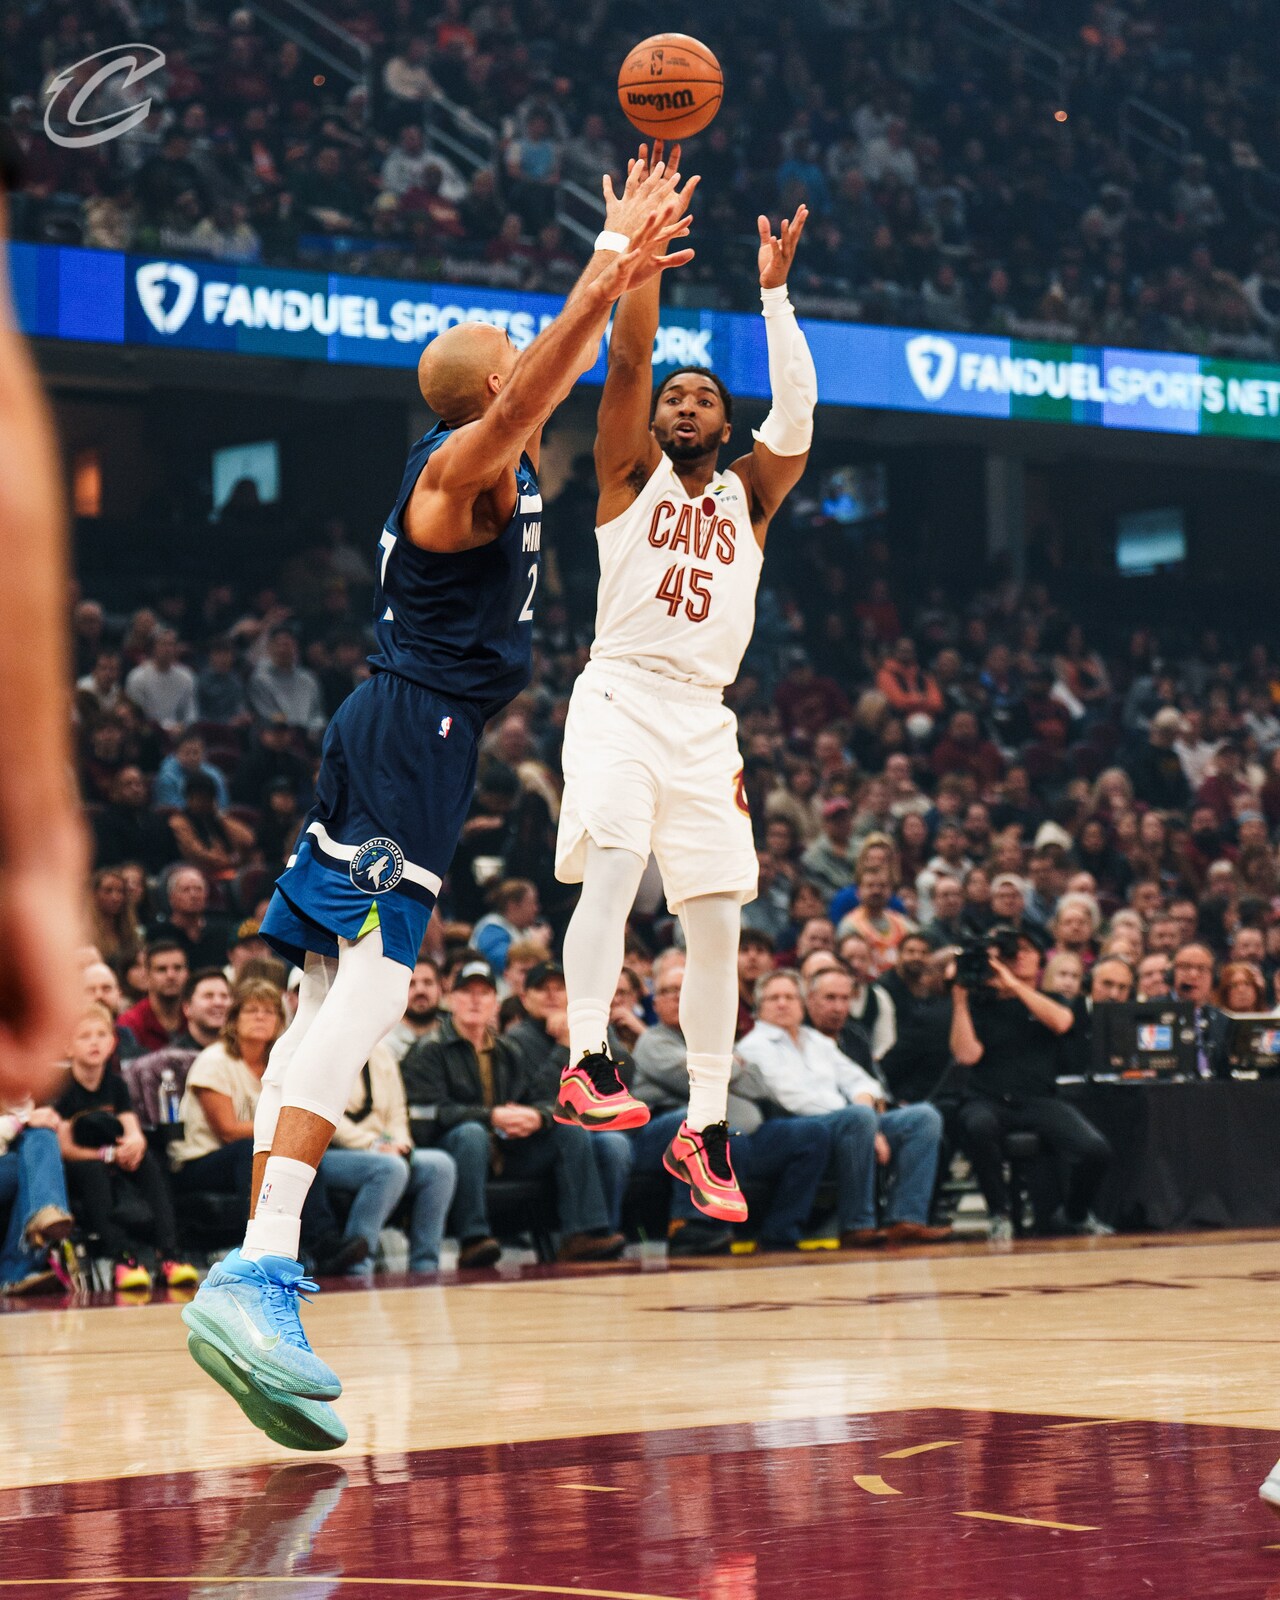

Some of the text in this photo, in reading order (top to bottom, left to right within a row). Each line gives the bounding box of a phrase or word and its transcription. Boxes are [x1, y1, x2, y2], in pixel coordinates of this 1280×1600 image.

[627, 89, 695, 111] Wilson
[203, 281, 390, 340] FANDUEL
[960, 353, 1106, 402] FANDUEL
[1106, 366, 1226, 414] SPORTS
[648, 500, 736, 565] CAVS
[518, 563, 538, 621] 2
[655, 563, 713, 623] 45
[352, 840, 403, 889] MINNESOTA TIMBERWOLVES
